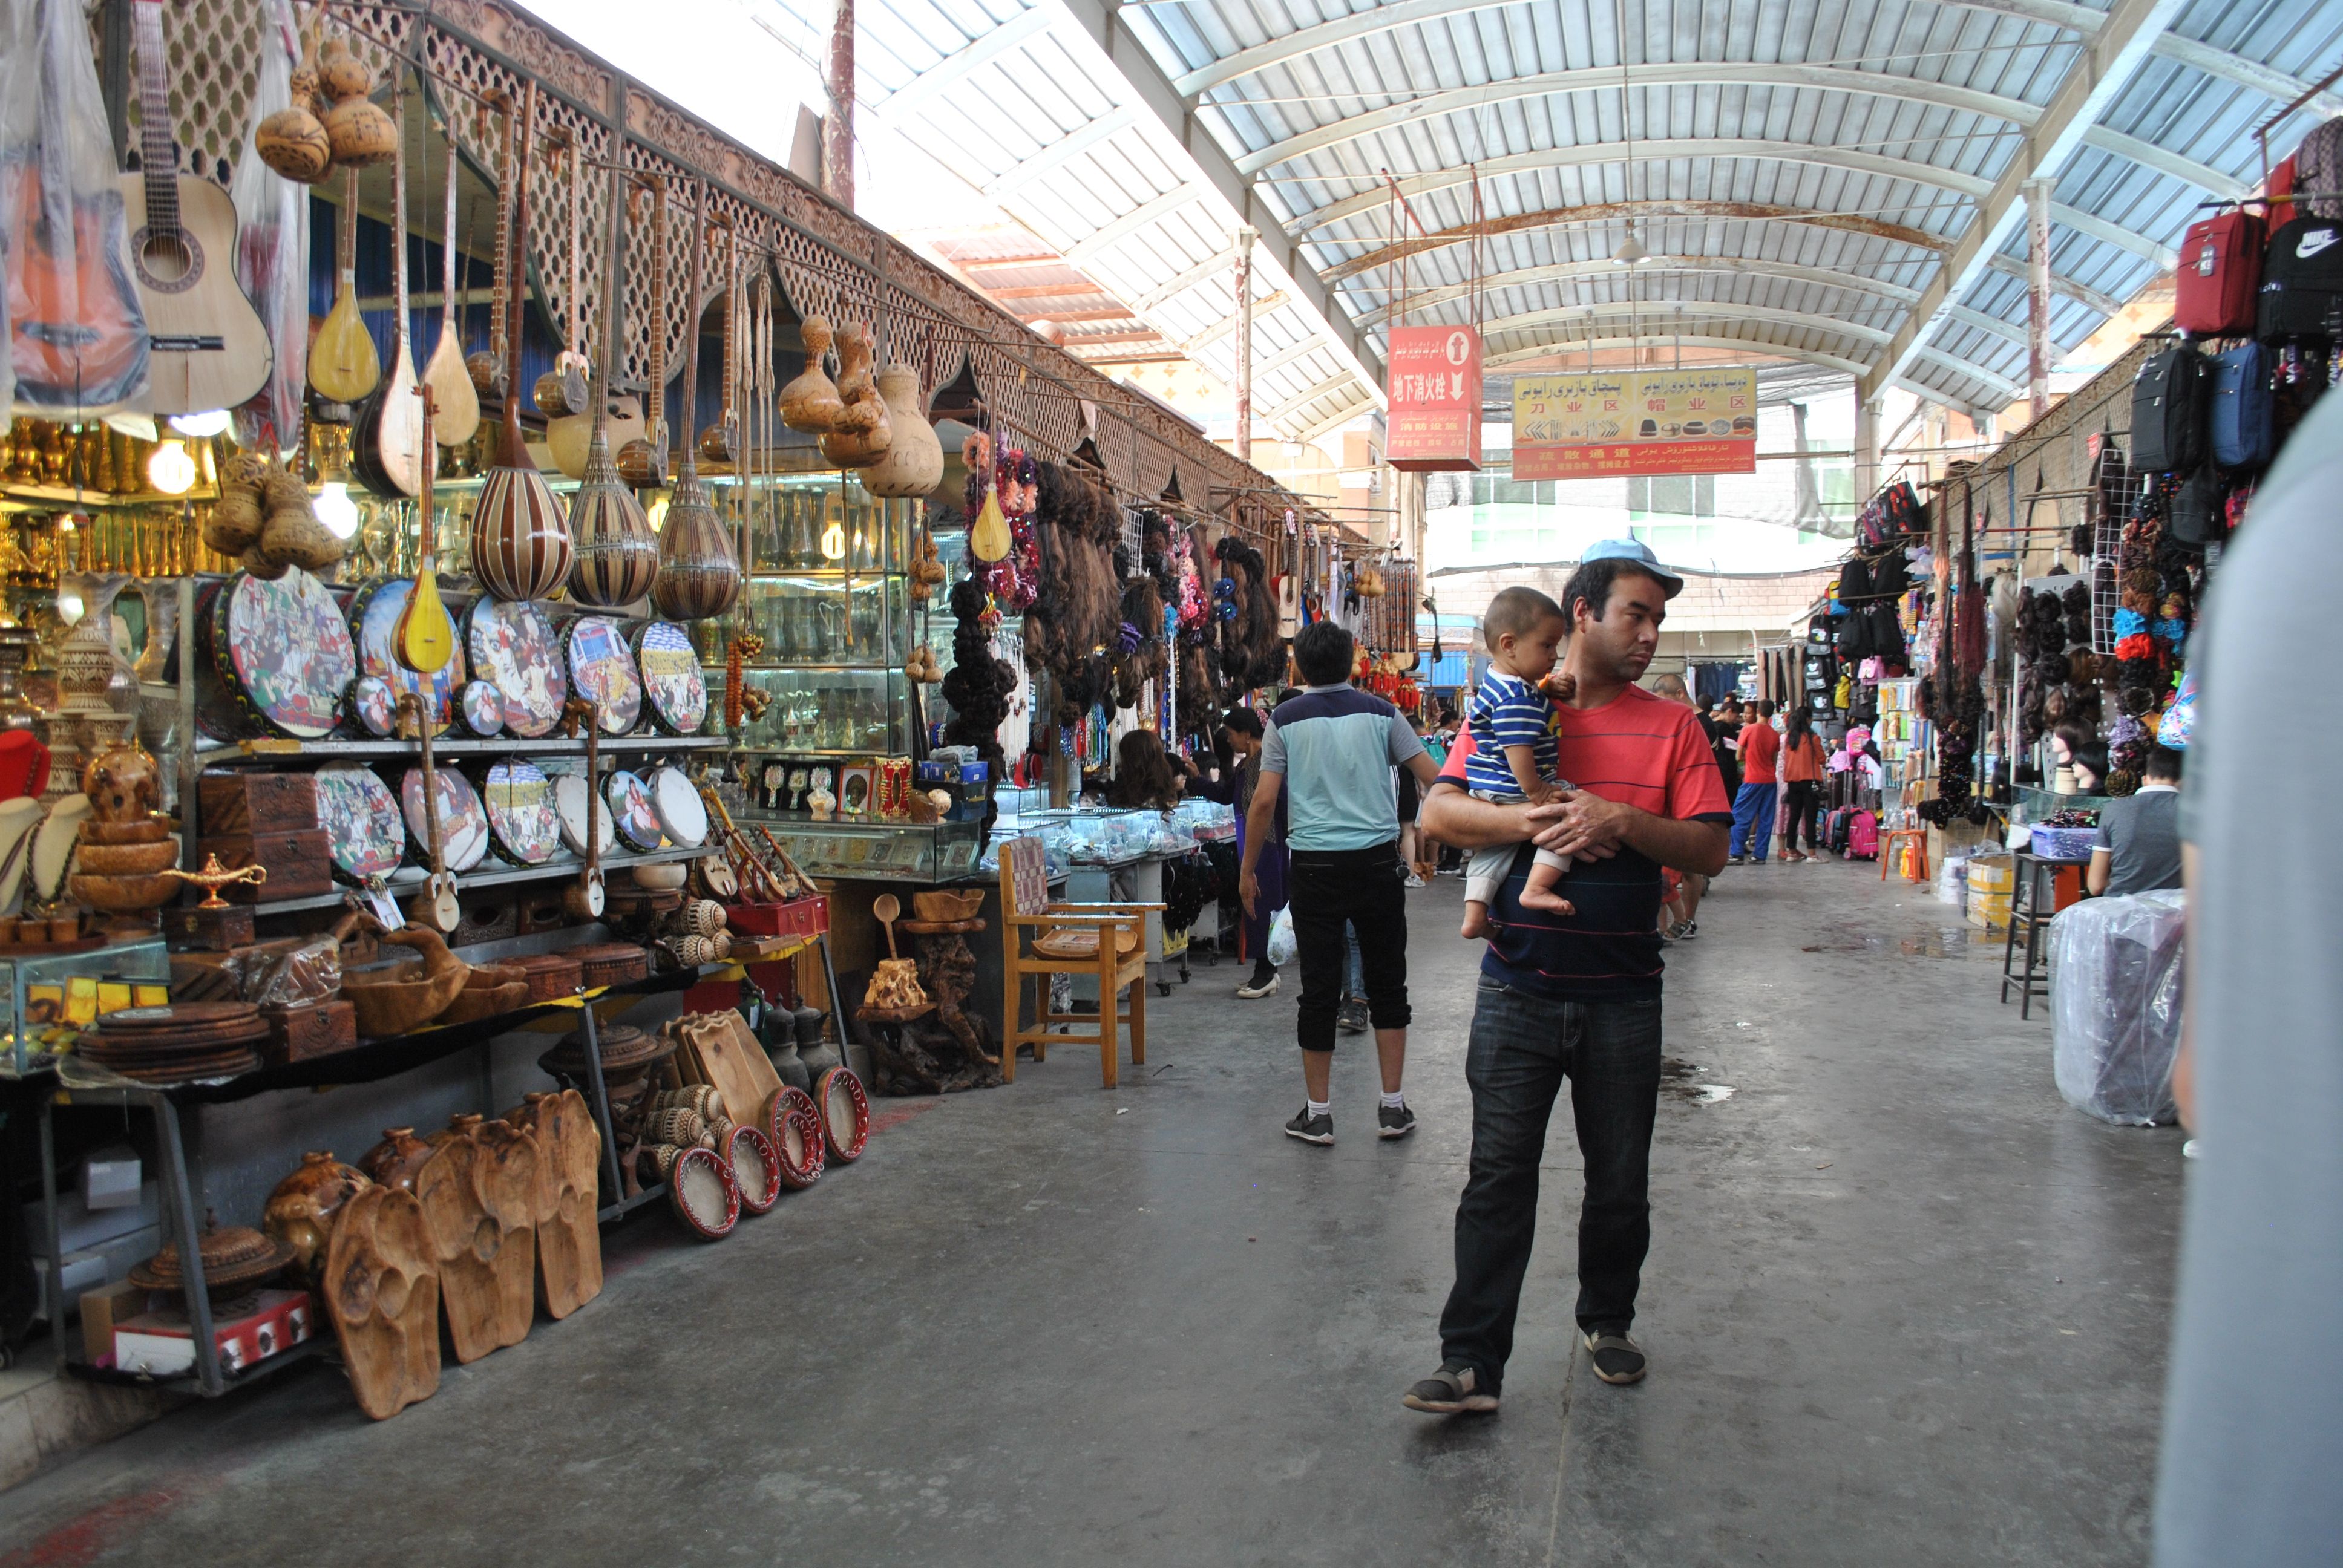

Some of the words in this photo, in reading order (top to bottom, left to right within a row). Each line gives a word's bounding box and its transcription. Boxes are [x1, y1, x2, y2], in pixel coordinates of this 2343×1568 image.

[2302, 229, 2333, 247] NIKE
[1393, 372, 1446, 402] 地下消火栓
[1400, 422, 1458, 431] 消防设施
[1539, 448, 1631, 460] 疏散通道
